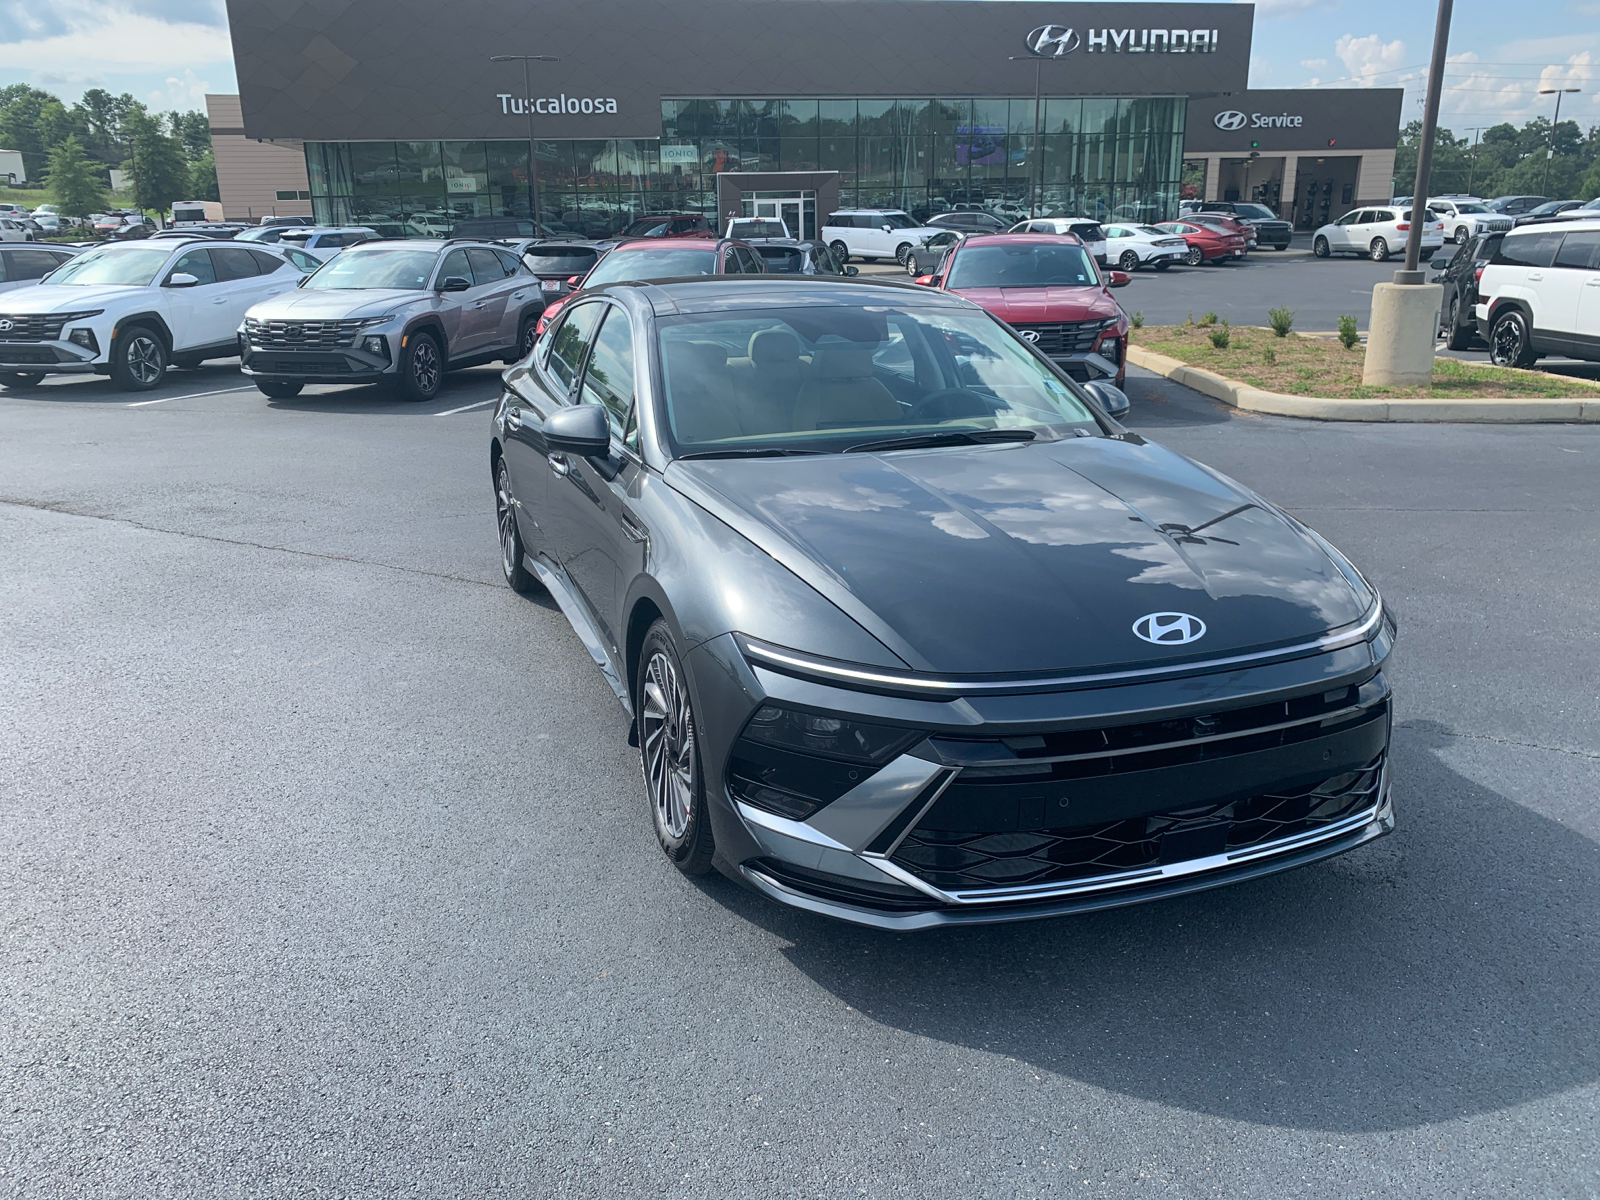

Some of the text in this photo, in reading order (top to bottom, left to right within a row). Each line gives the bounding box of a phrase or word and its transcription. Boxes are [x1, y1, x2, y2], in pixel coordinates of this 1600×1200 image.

[1088, 29, 1218, 53] HYUNDAI
[496, 93, 618, 115] Tuscaloosa
[1250, 112, 1303, 128] Service
